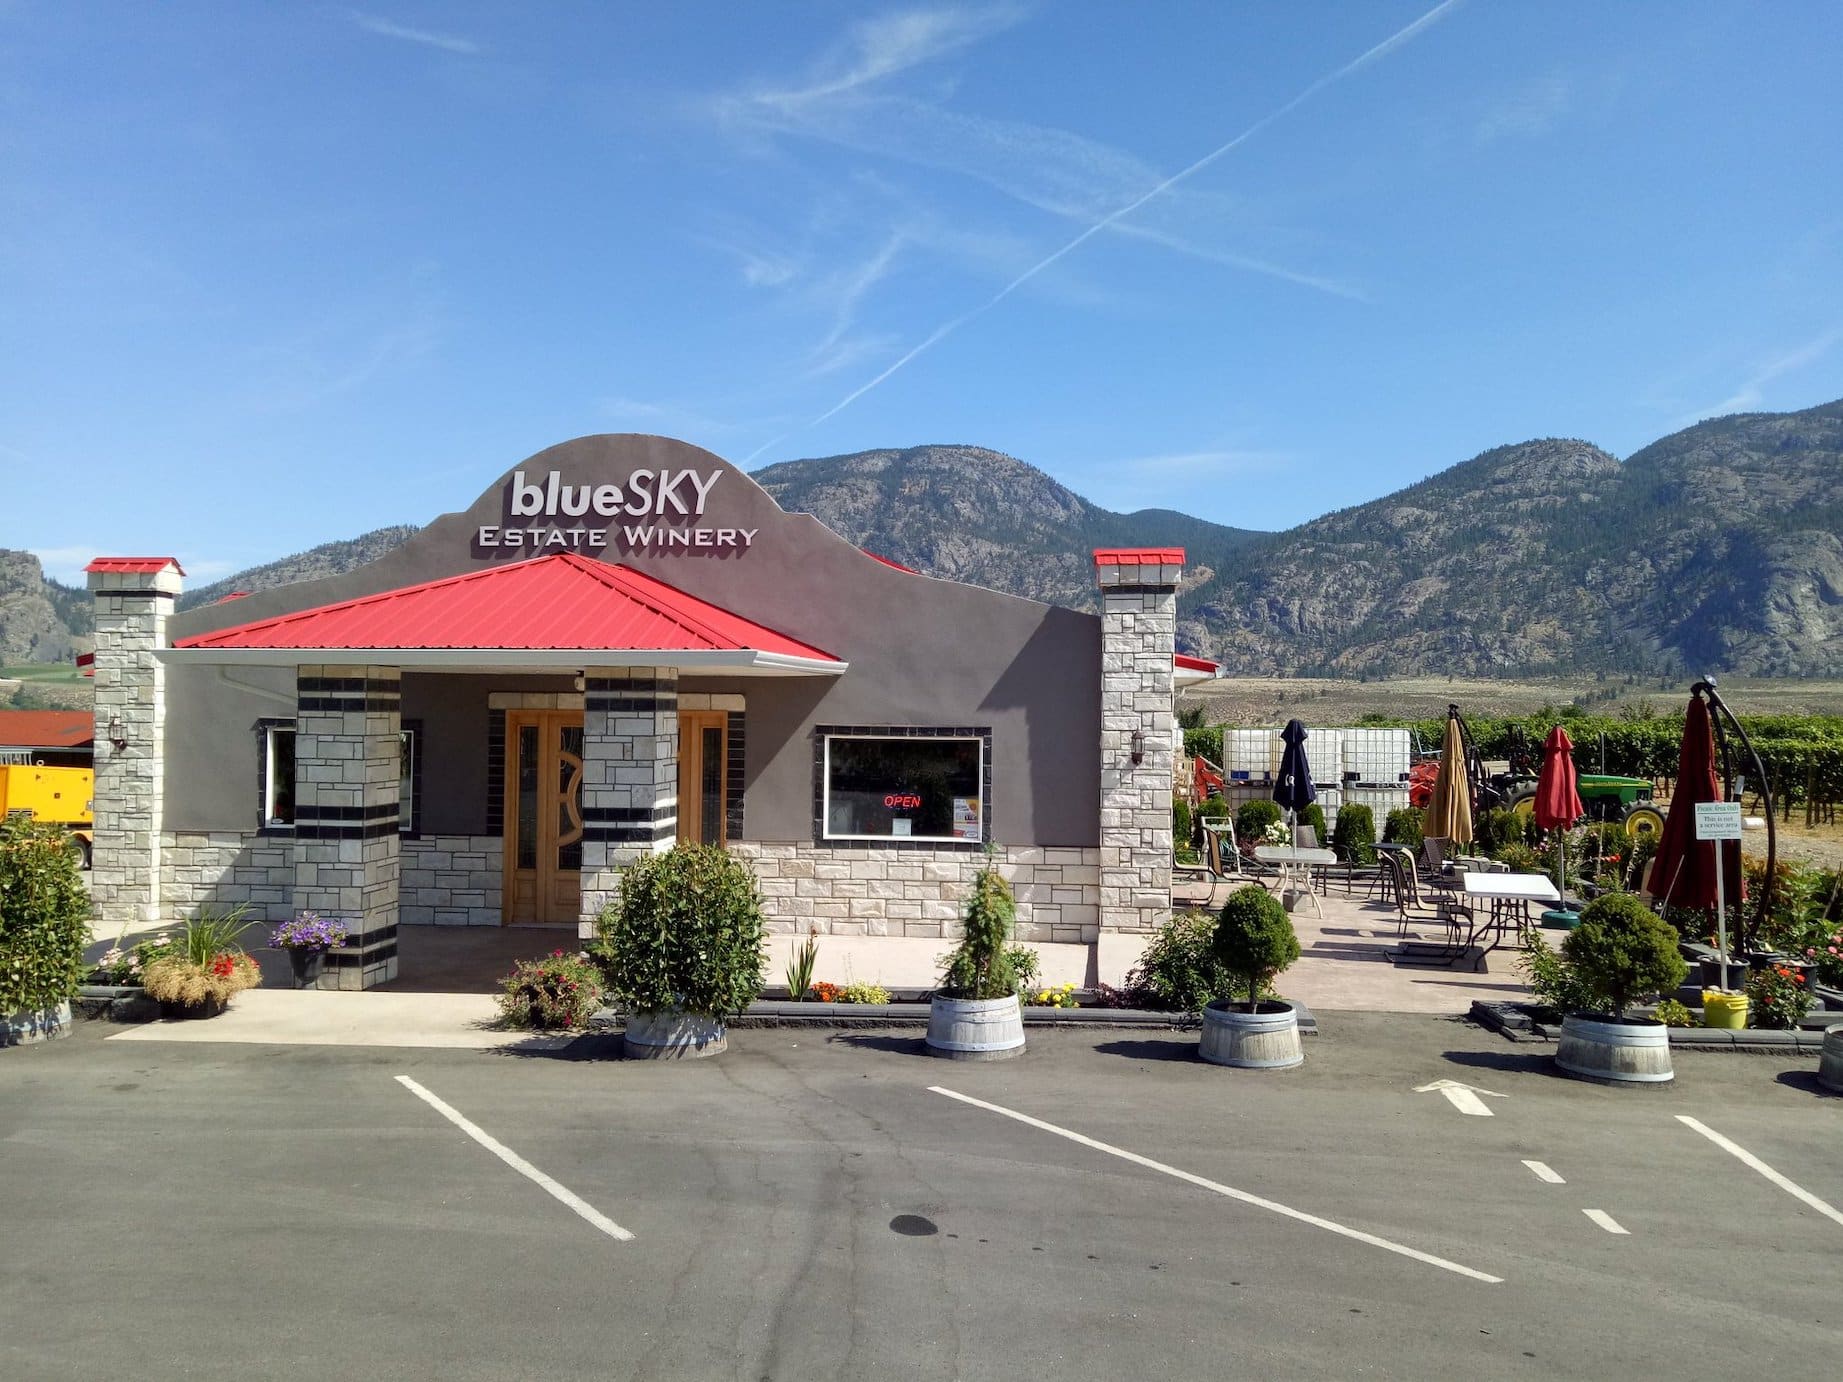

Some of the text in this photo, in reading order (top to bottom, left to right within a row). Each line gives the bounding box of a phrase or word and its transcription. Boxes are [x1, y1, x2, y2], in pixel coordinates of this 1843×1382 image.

[510, 468, 724, 517] blueSKY
[479, 525, 759, 547] ESTATE WINERY
[884, 795, 921, 808] OPEN
